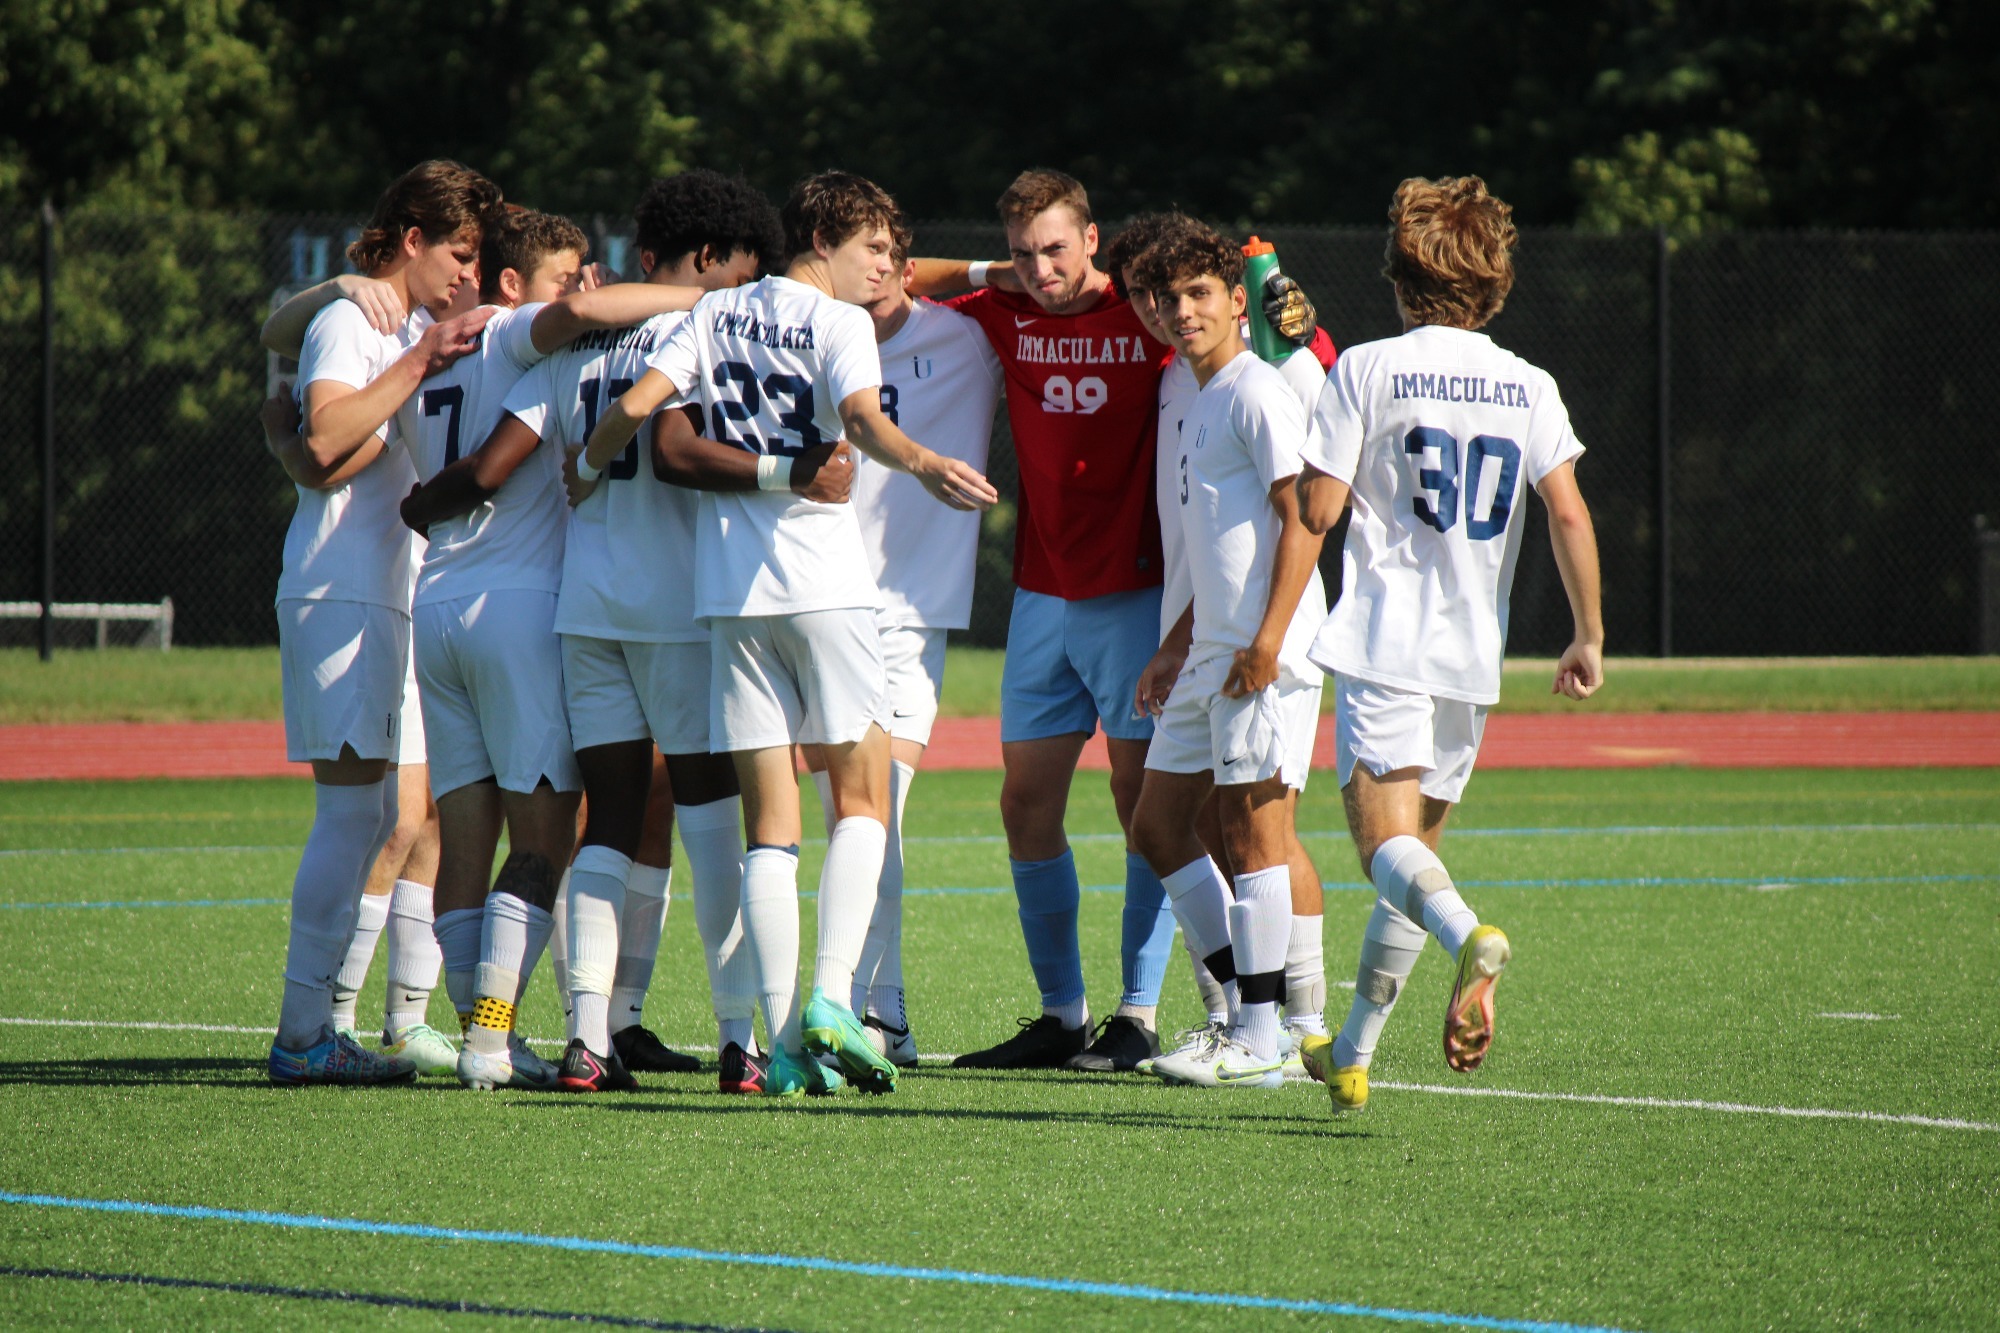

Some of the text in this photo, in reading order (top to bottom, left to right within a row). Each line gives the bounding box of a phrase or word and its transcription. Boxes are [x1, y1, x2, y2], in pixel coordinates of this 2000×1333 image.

[1016, 334, 1147, 364] IMMACULATA
[711, 360, 823, 458] 23
[1041, 375, 1108, 415] 99
[1392, 373, 1530, 409] IMMACULATA
[423, 384, 465, 469] 7
[1404, 425, 1522, 541] 30
